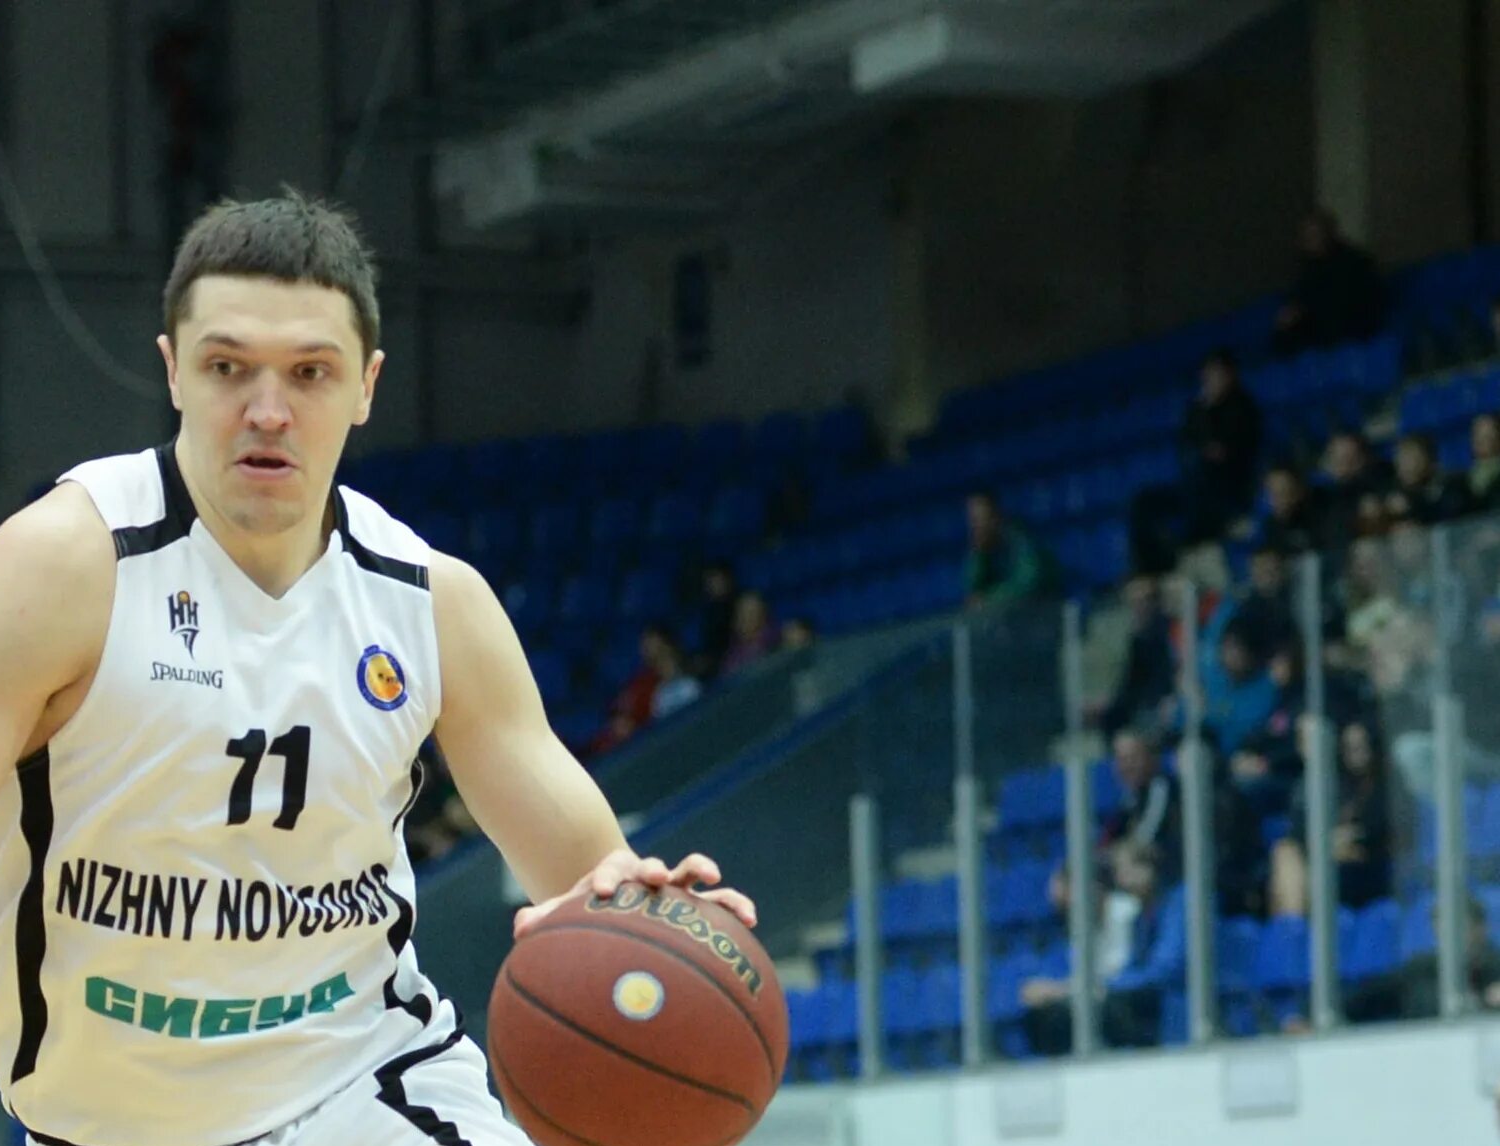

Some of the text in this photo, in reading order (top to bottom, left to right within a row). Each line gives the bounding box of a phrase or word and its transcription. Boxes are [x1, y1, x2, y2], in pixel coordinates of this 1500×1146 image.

[150, 661, 224, 689] SPALDING
[225, 725, 311, 831] 11
[56, 858, 208, 941] NIZHNY
